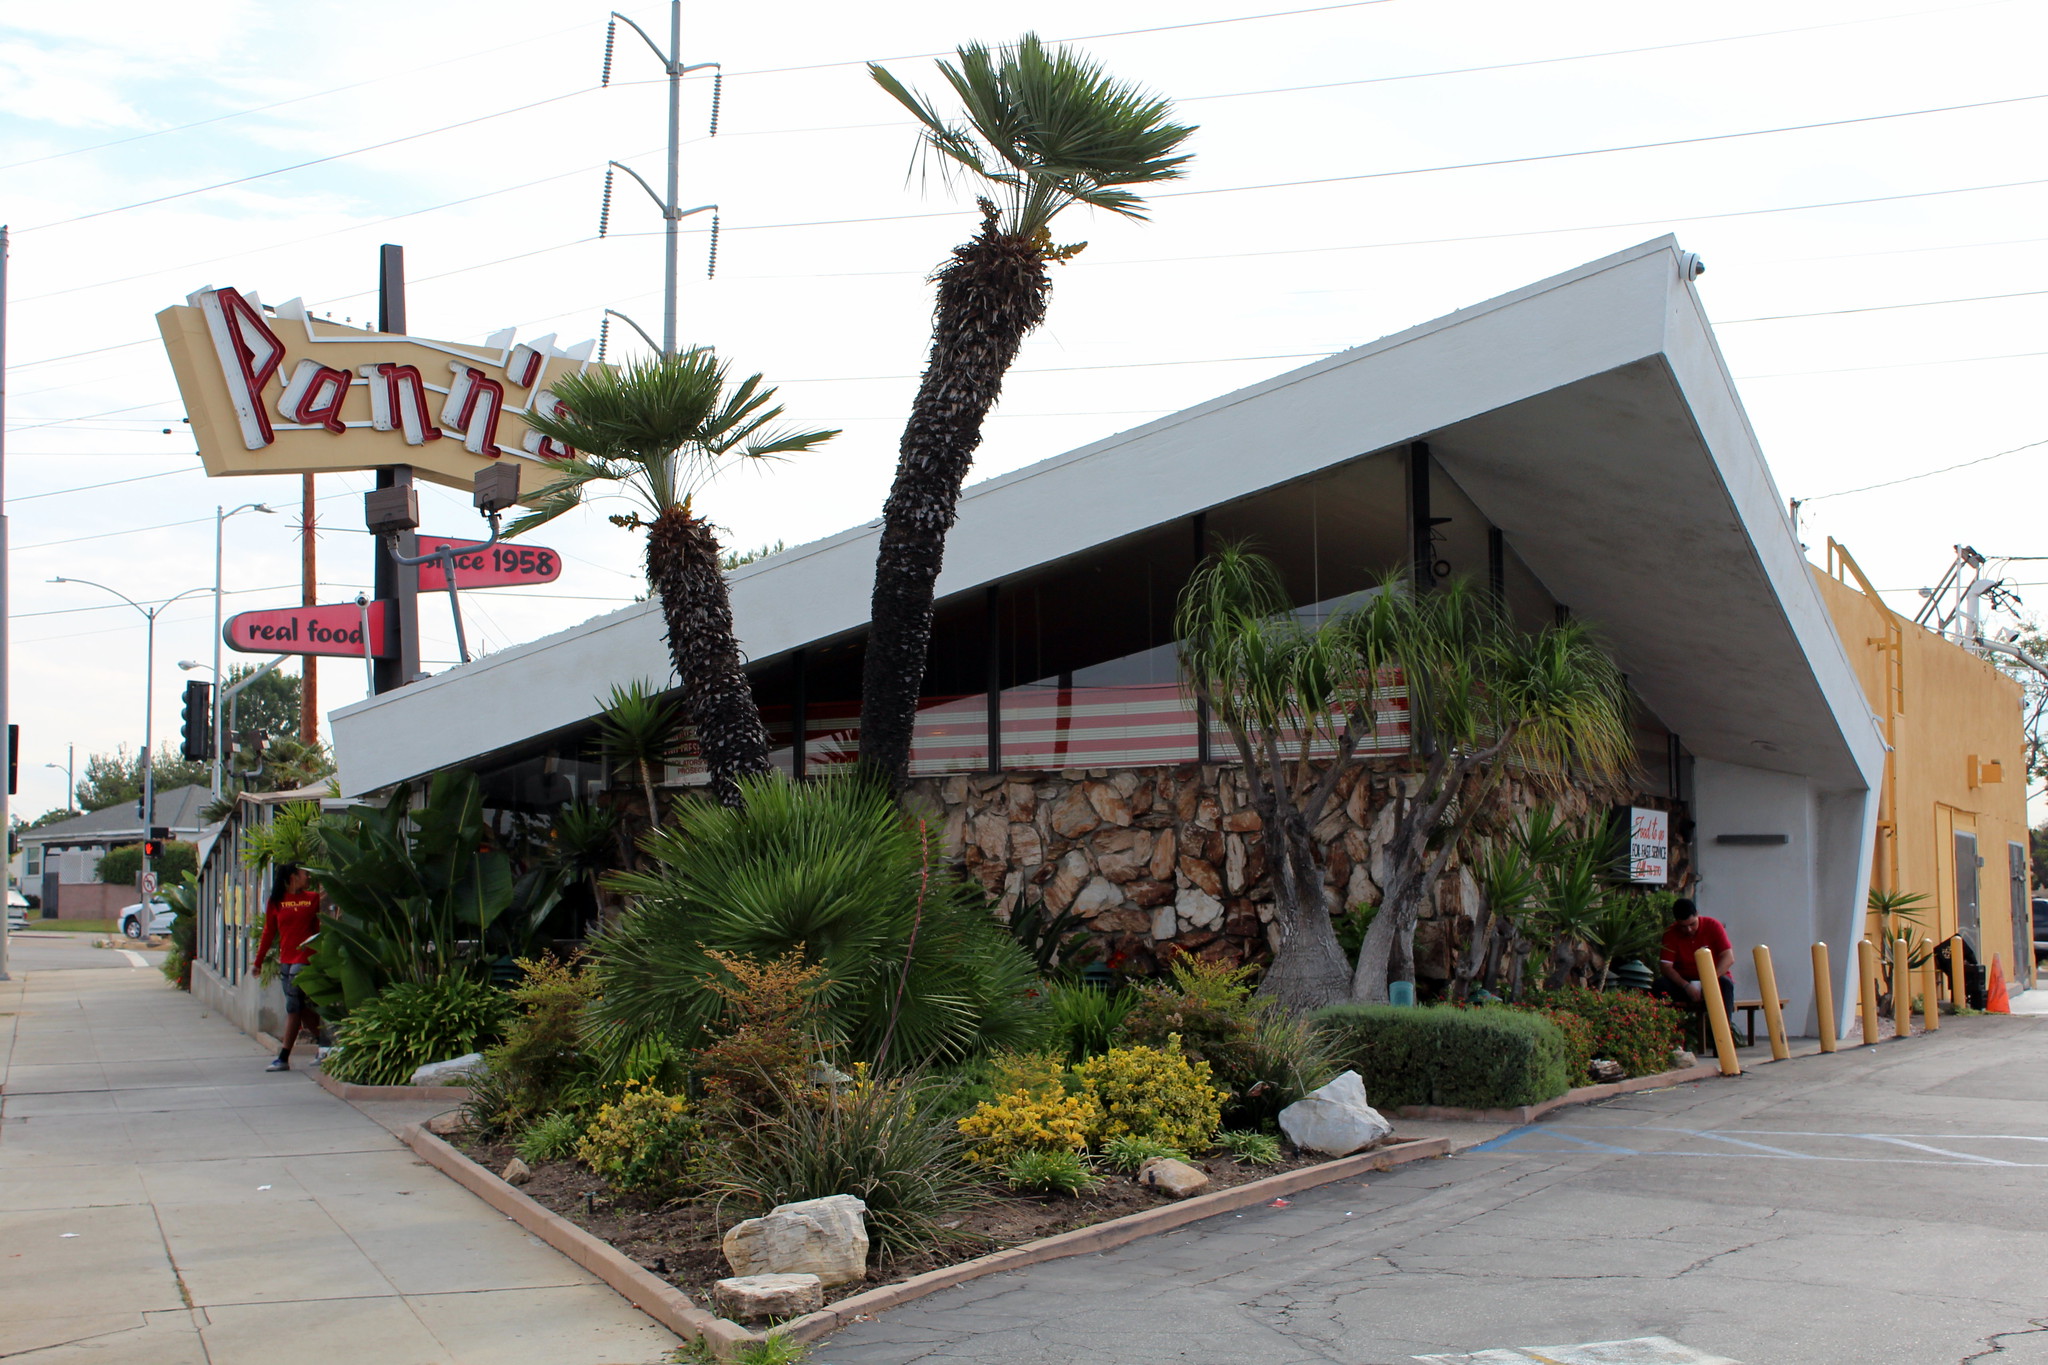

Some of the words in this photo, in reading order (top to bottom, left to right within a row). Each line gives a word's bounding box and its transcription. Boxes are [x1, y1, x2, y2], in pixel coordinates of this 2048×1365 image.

[492, 548, 554, 576] 1958
[249, 617, 298, 641] real
[307, 619, 366, 644] food
[1635, 816, 1651, 840] Food
[1652, 816, 1658, 840] to
[1632, 843, 1640, 857] FOR
[1641, 844, 1651, 858] FAST
[1651, 846, 1666, 860] SERVICE
